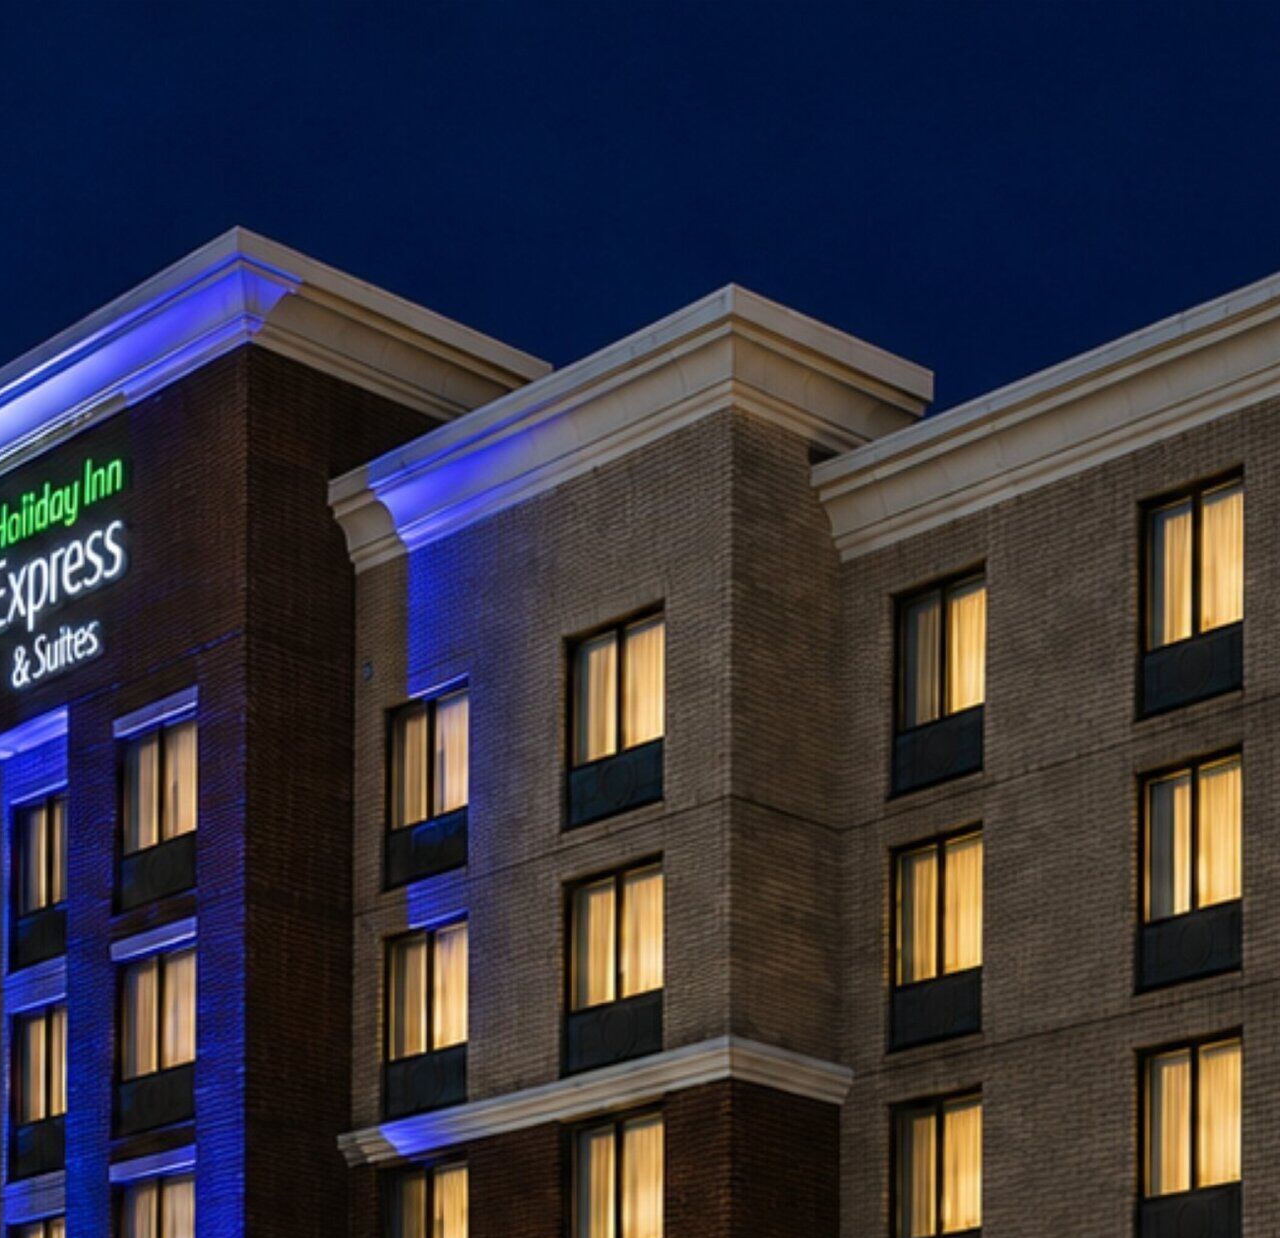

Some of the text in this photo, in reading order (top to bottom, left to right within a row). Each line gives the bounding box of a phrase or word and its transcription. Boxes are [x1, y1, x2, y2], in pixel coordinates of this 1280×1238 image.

[84, 458, 122, 505] Inn
[11, 621, 99, 688] & Suites
